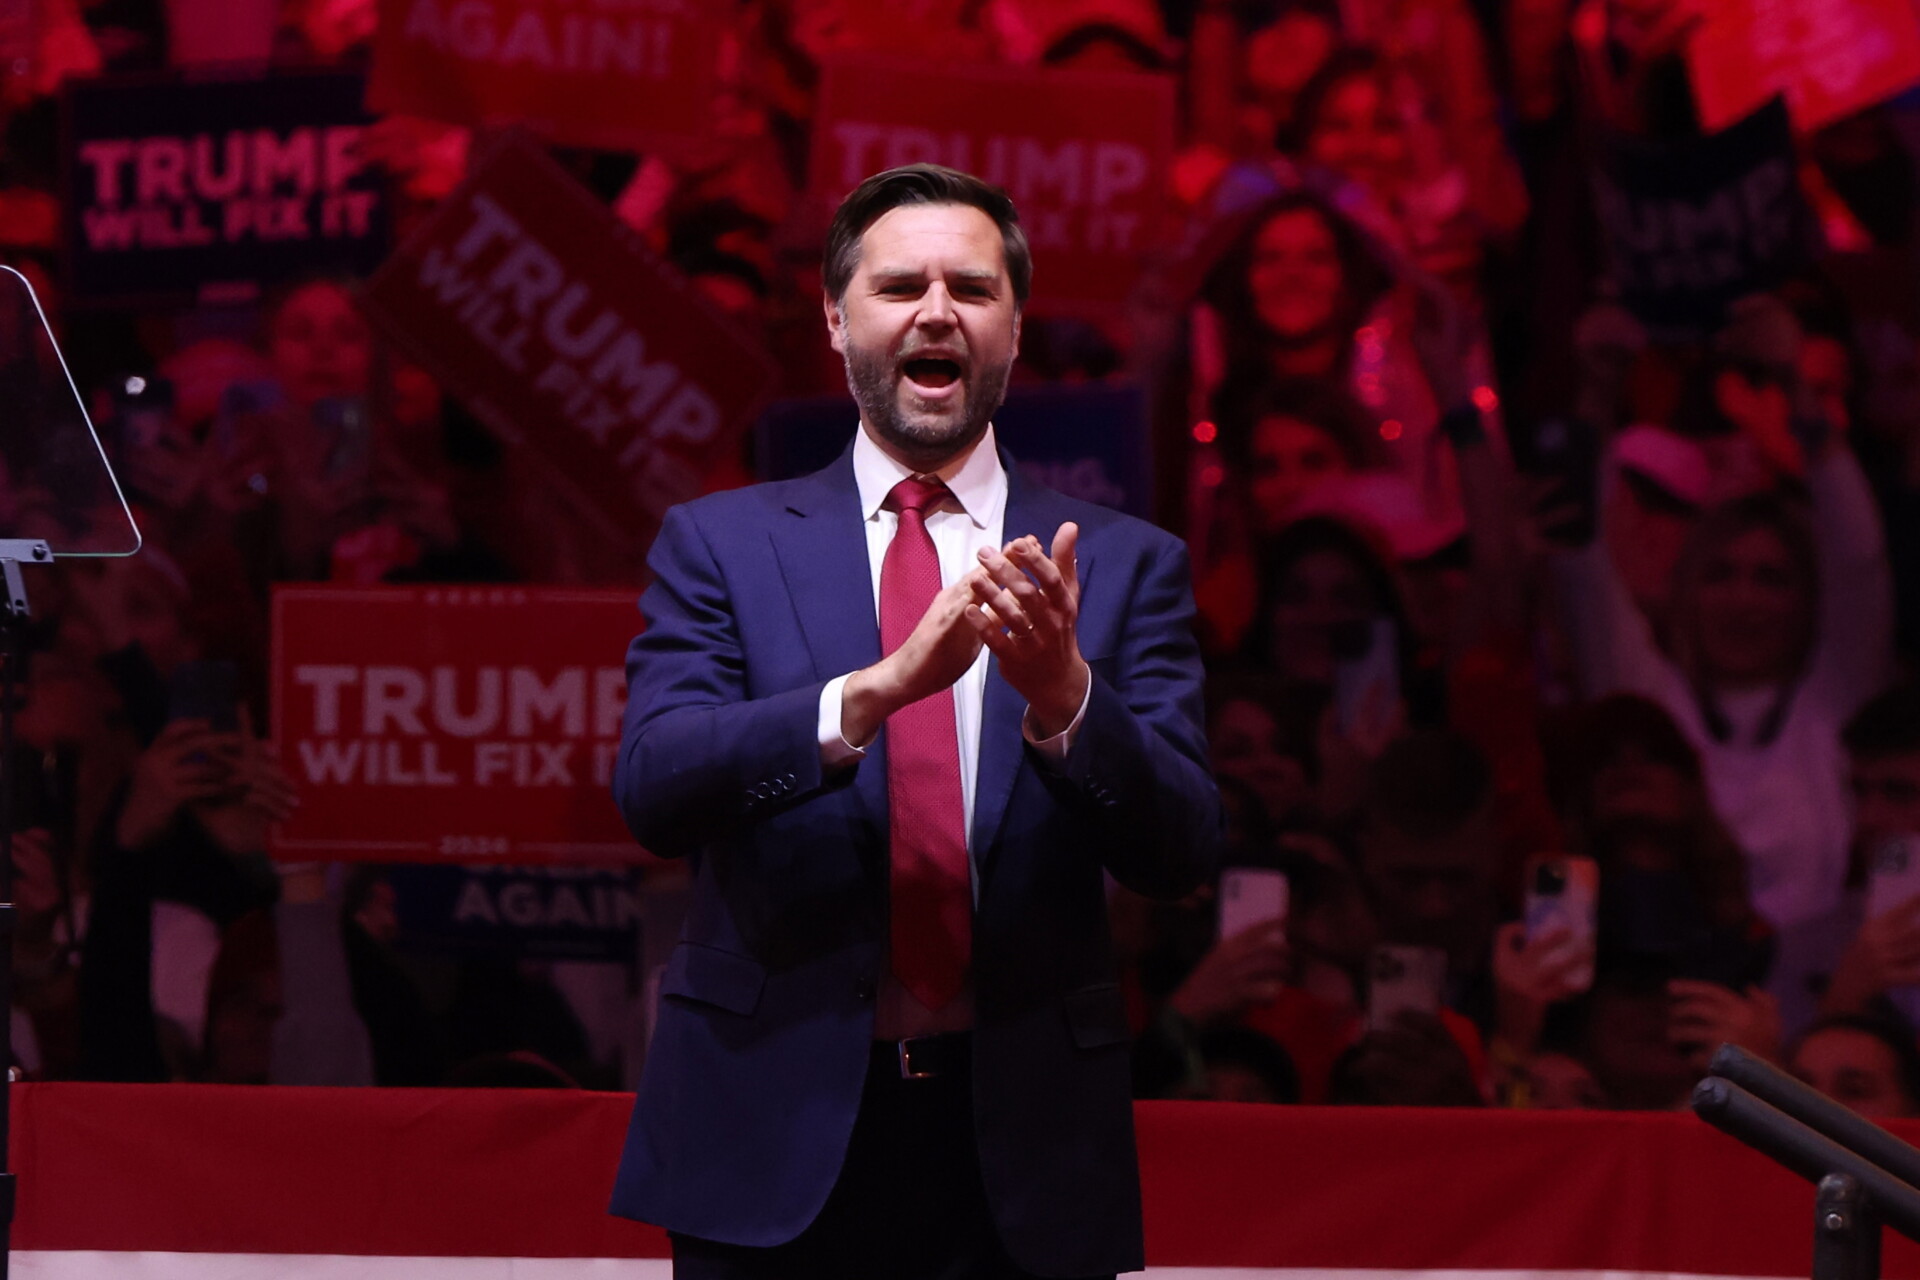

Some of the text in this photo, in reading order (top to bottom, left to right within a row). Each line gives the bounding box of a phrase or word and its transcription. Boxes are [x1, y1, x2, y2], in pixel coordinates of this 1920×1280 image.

[319, 190, 376, 238] IT
[418, 248, 530, 374] WILL
[453, 190, 722, 443] TRUMP
[298, 740, 460, 787] WILL
[473, 740, 577, 788] FIX
